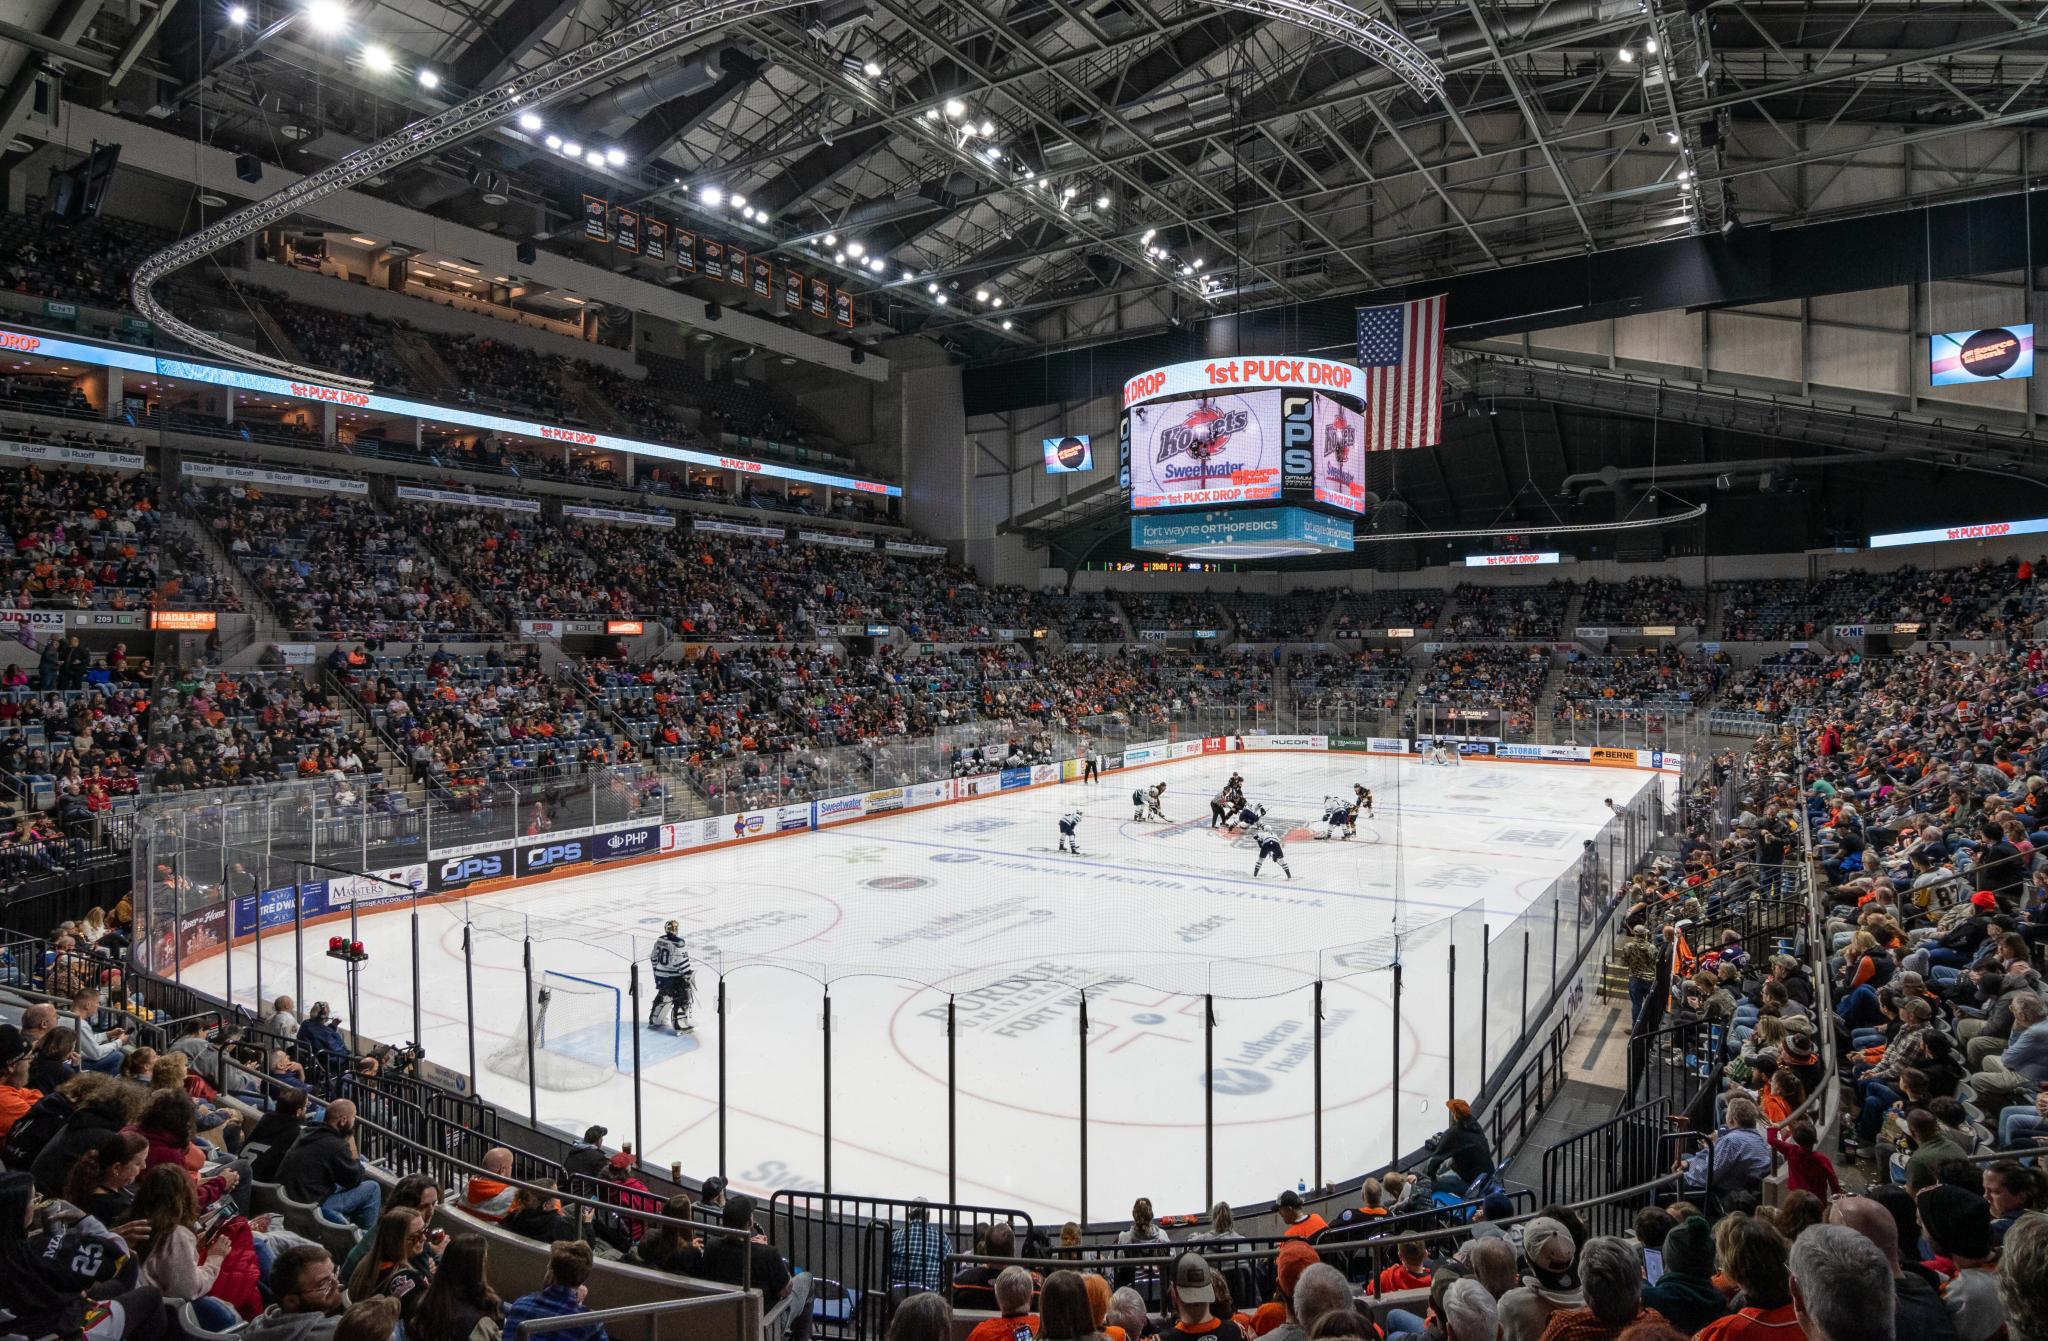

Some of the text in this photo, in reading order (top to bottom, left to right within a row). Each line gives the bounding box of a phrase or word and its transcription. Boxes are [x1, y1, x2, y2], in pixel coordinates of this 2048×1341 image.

[0, 332, 40, 351] DROP
[1205, 360, 1352, 389] 1st PUCK DROP
[1131, 372, 1166, 402] DROP
[309, 386, 338, 402] PUCK
[341, 391, 369, 406] DROP
[553, 429, 575, 441] PUCK
[576, 433, 596, 445] DROP
[1157, 409, 1249, 464] Koets
[72, 450, 95, 459] Ruoff
[119, 456, 141, 464] Ruoff
[1165, 461, 1244, 479] Sweetwater
[1184, 490, 1211, 502] PUCK
[1212, 488, 1241, 500] DROP
[1143, 520, 1278, 537] fort wayne ORTHOPEDICS
[1946, 524, 2010, 539] 1st PUCK DROP
[1520, 555, 1539, 563] DROP
[26, 612, 64, 624] 103.3
[1835, 627, 1864, 637] ZONE
[1509, 746, 1541, 756] STORAGE
[1605, 750, 1634, 760] BERNE
[821, 798, 863, 813] Sweetwater
[625, 831, 648, 846] PHP
[528, 843, 582, 868] OPS
[441, 855, 502, 882] OPS
[204, 909, 225, 924] Home
[993, 1007, 1064, 1038] FORT
[1224, 1019, 1304, 1066] Lutheran
[71, 1242, 103, 1278] 25
